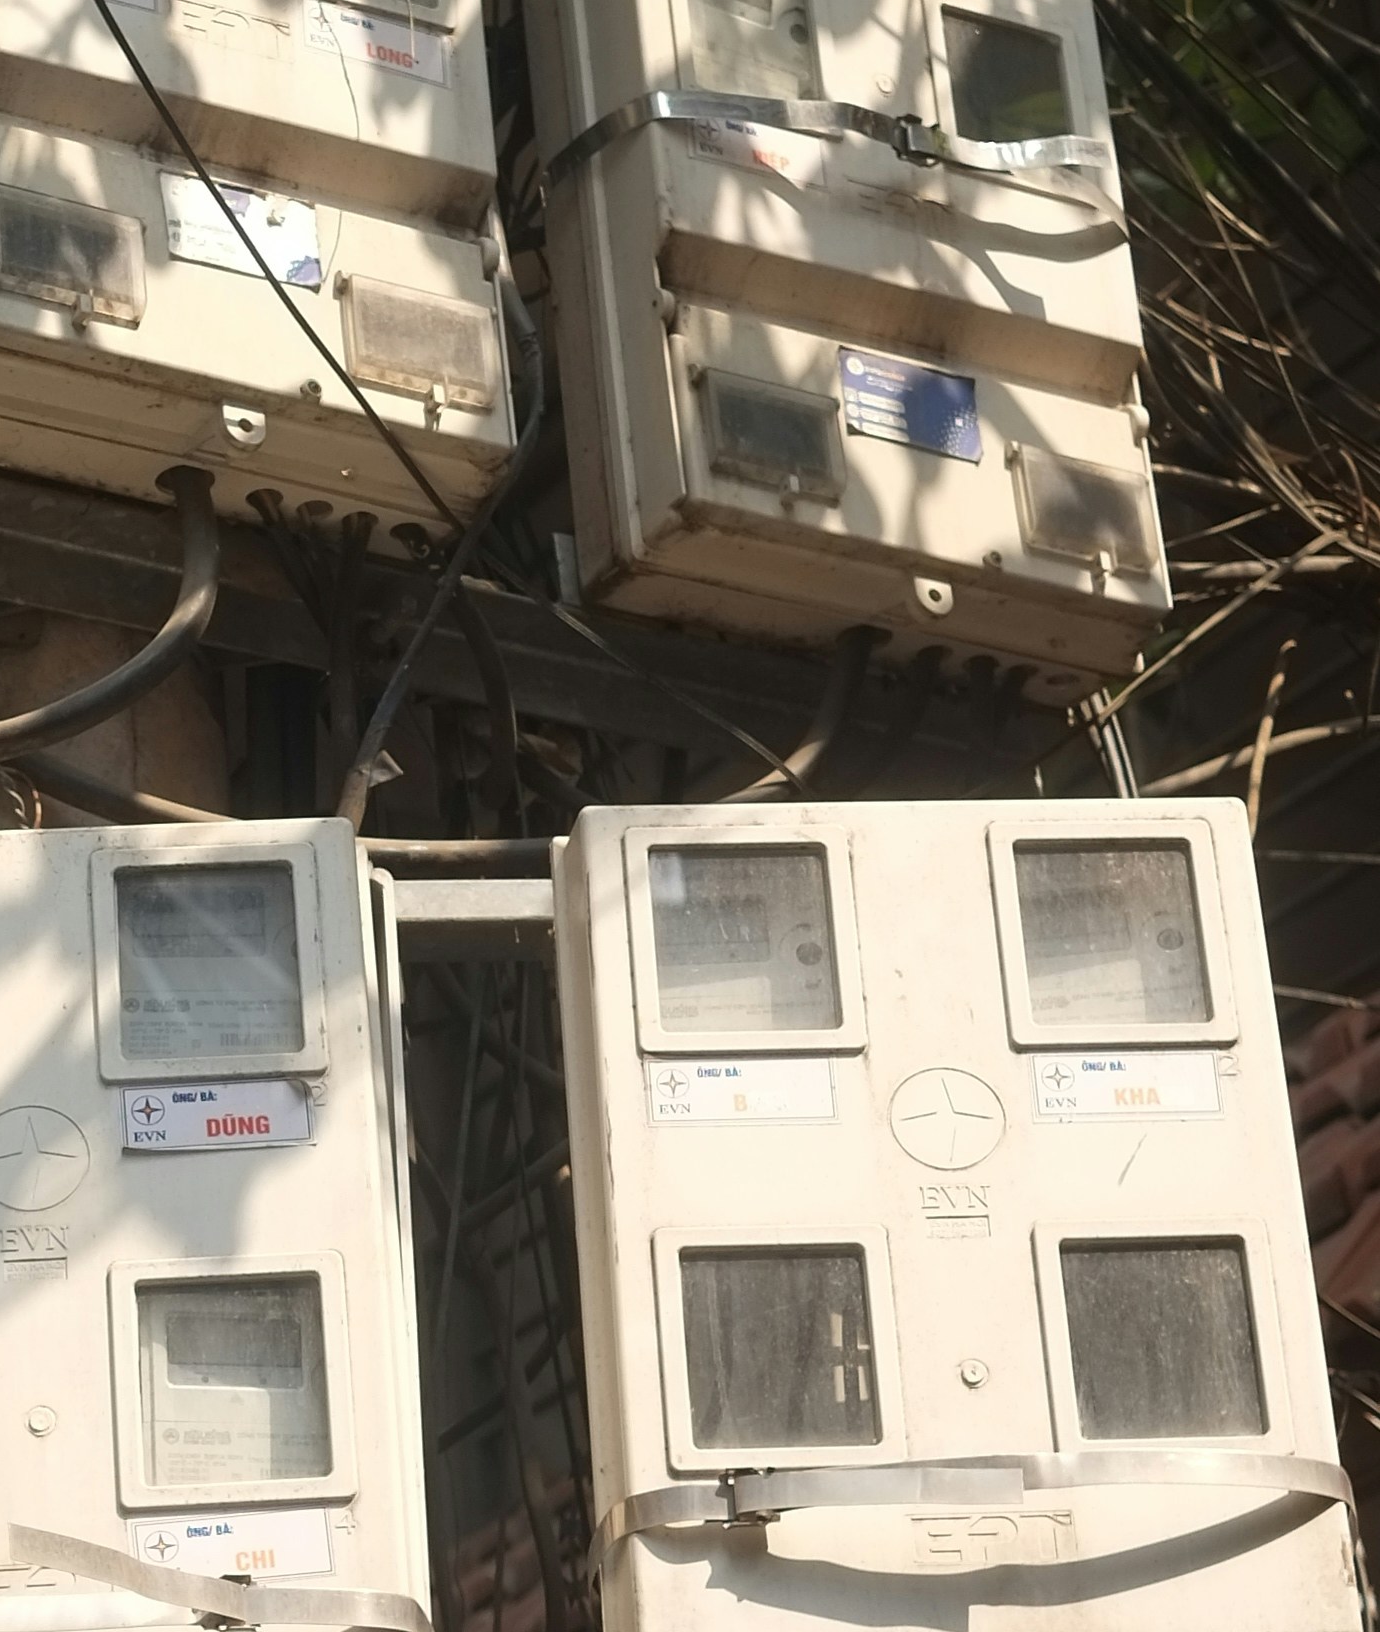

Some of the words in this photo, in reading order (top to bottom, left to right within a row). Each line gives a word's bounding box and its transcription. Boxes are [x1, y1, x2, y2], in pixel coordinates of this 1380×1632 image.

[367, 42, 413, 68] LONG
[659, 1103, 691, 1114] EVN
[1045, 1097, 1077, 1108] EVN
[206, 1114, 270, 1137] DŨNG
[134, 1130, 166, 1142] EVN
[235, 1549, 275, 1572] CHI
